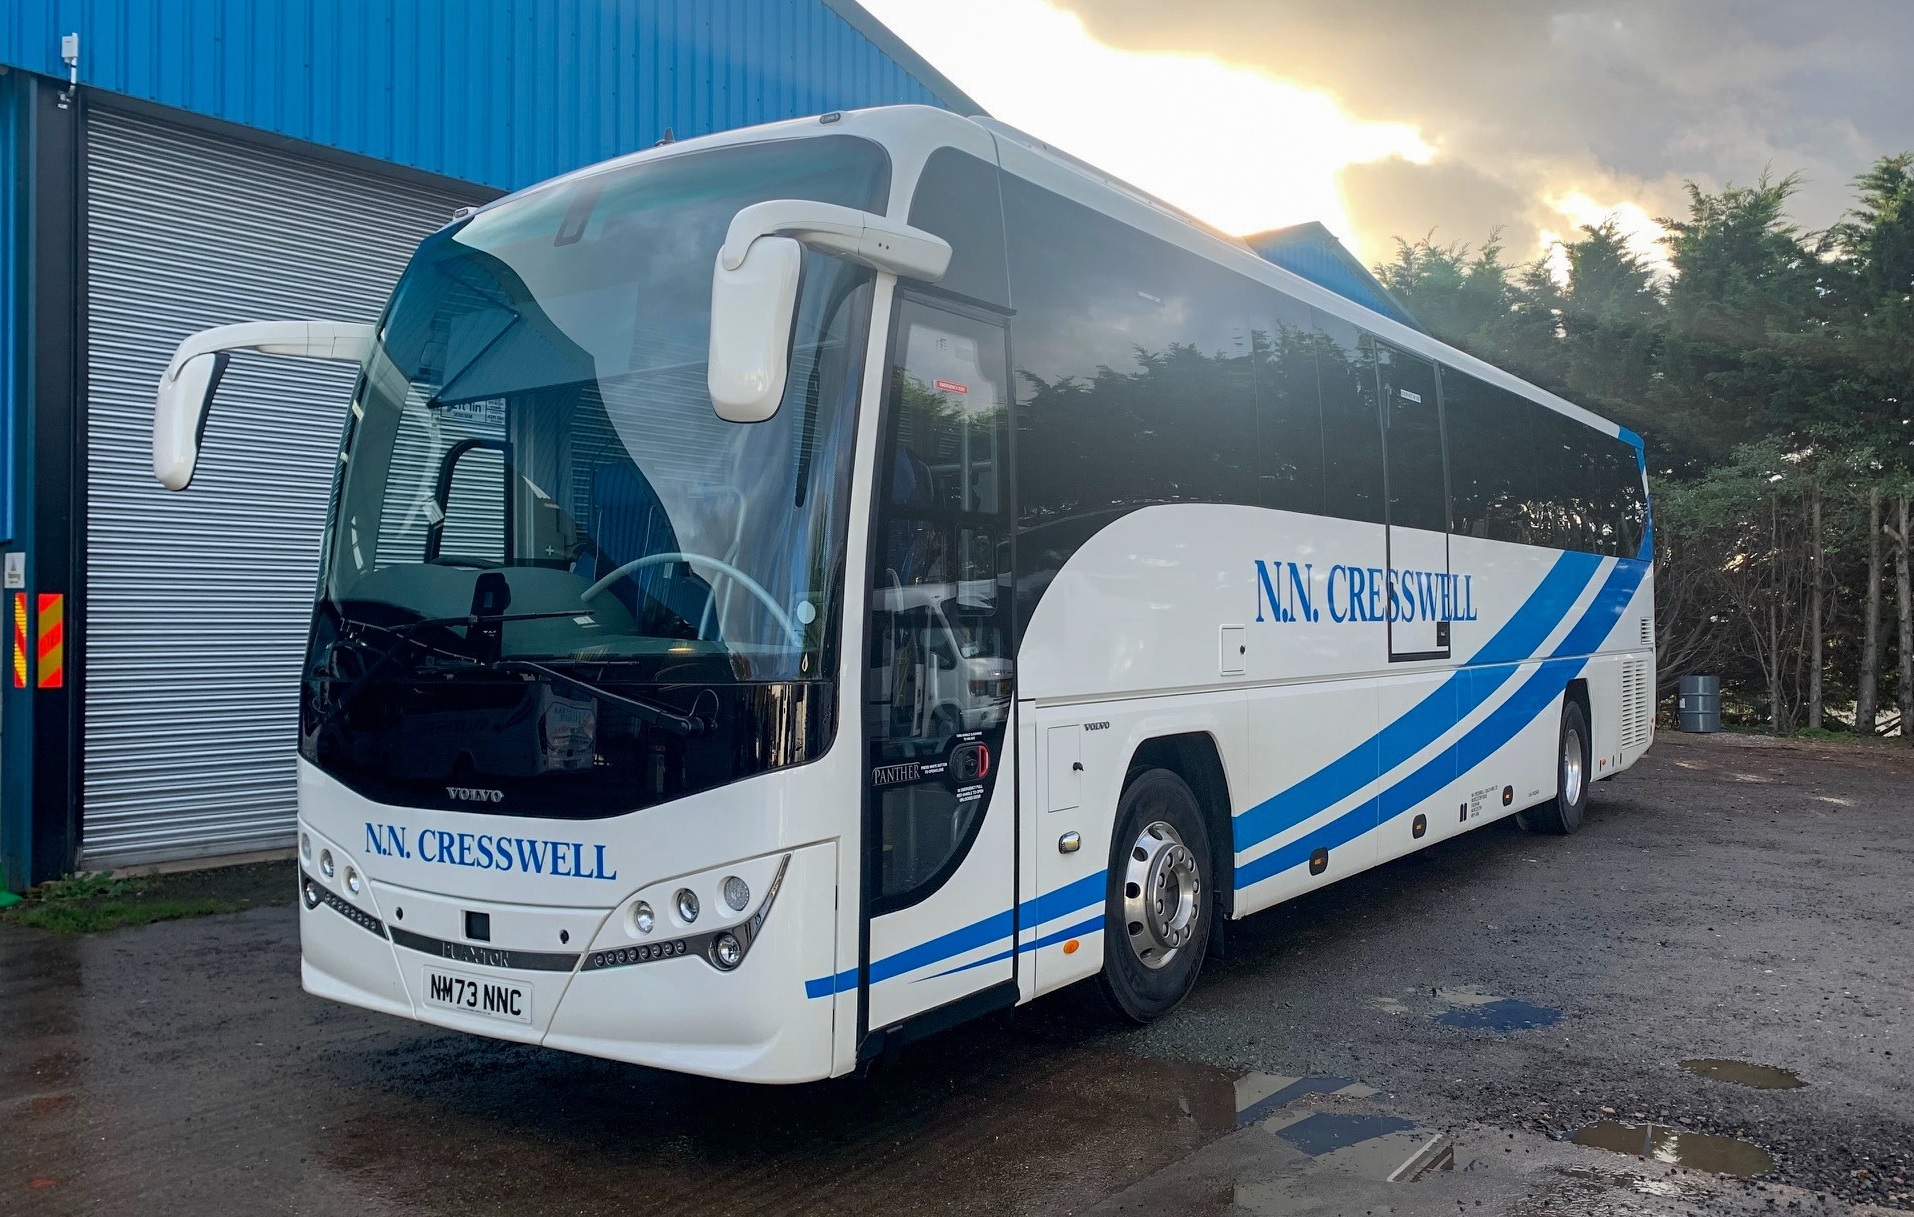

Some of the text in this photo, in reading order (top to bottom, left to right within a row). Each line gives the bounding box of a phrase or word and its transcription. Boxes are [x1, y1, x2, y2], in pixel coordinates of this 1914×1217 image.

[1254, 560, 1479, 624] N.N. CRESSWELL
[1084, 721, 1110, 732] VOLVO
[874, 763, 921, 785] PANTHER
[446, 786, 505, 803] VOLVO
[365, 822, 618, 881] N.N. CRESSWELL
[431, 974, 522, 1016] NM73 NNC
